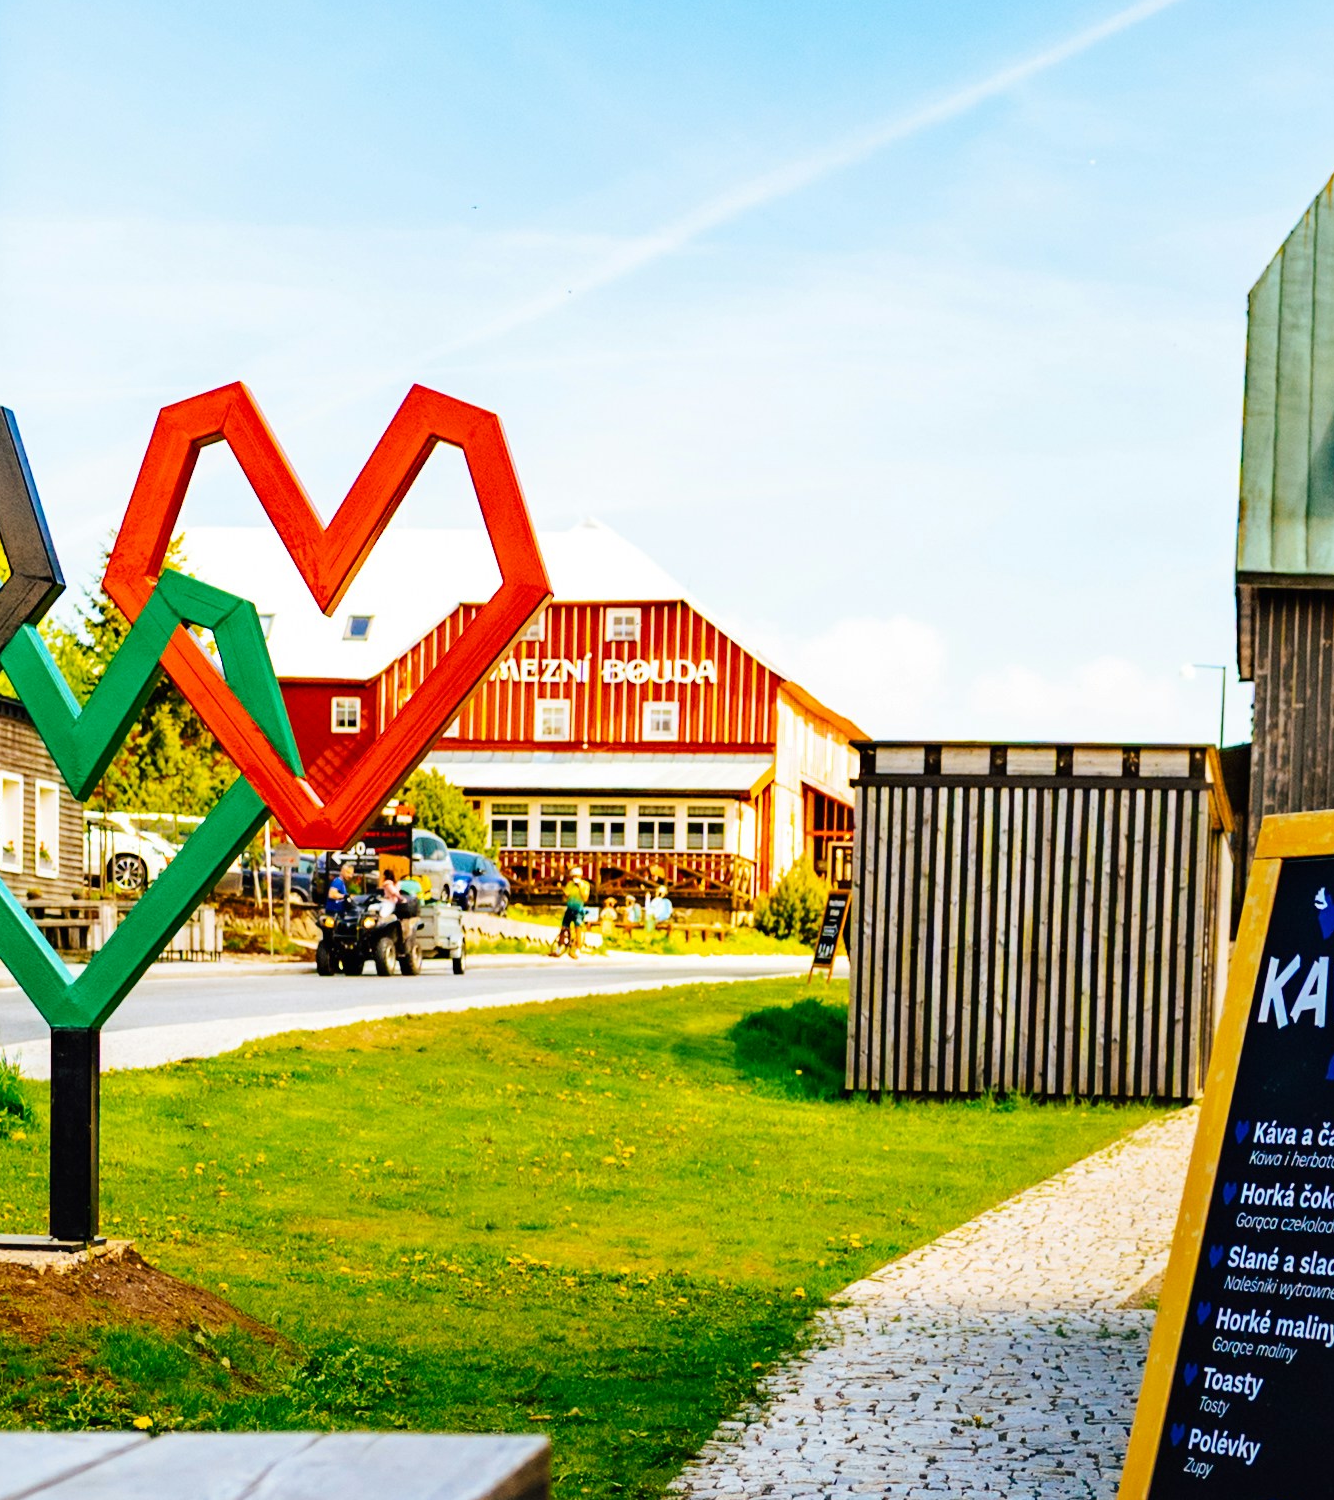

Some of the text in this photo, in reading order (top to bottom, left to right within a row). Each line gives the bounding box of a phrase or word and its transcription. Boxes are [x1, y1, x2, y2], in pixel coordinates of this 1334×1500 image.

[489, 652, 719, 685] MEZNÍ BOUDA
[1252, 1120, 1296, 1146] Káva
[1301, 1129, 1313, 1146] a
[1248, 1150, 1281, 1167] Kawa
[1284, 1151, 1291, 1167] i
[1239, 1181, 1295, 1208] Horká
[1236, 1212, 1278, 1233] Gorąca
[1227, 1244, 1279, 1273] Slané
[1283, 1256, 1295, 1274] a
[1223, 1275, 1278, 1294] Naleśniki
[1215, 1307, 1271, 1334] Horké
[1212, 1336, 1298, 1365] Gorące maliny
[1203, 1366, 1264, 1401] Toasty
[1199, 1395, 1230, 1418] Tosty
[1188, 1427, 1261, 1466] Polévky
[1183, 1456, 1214, 1480] Zupy
